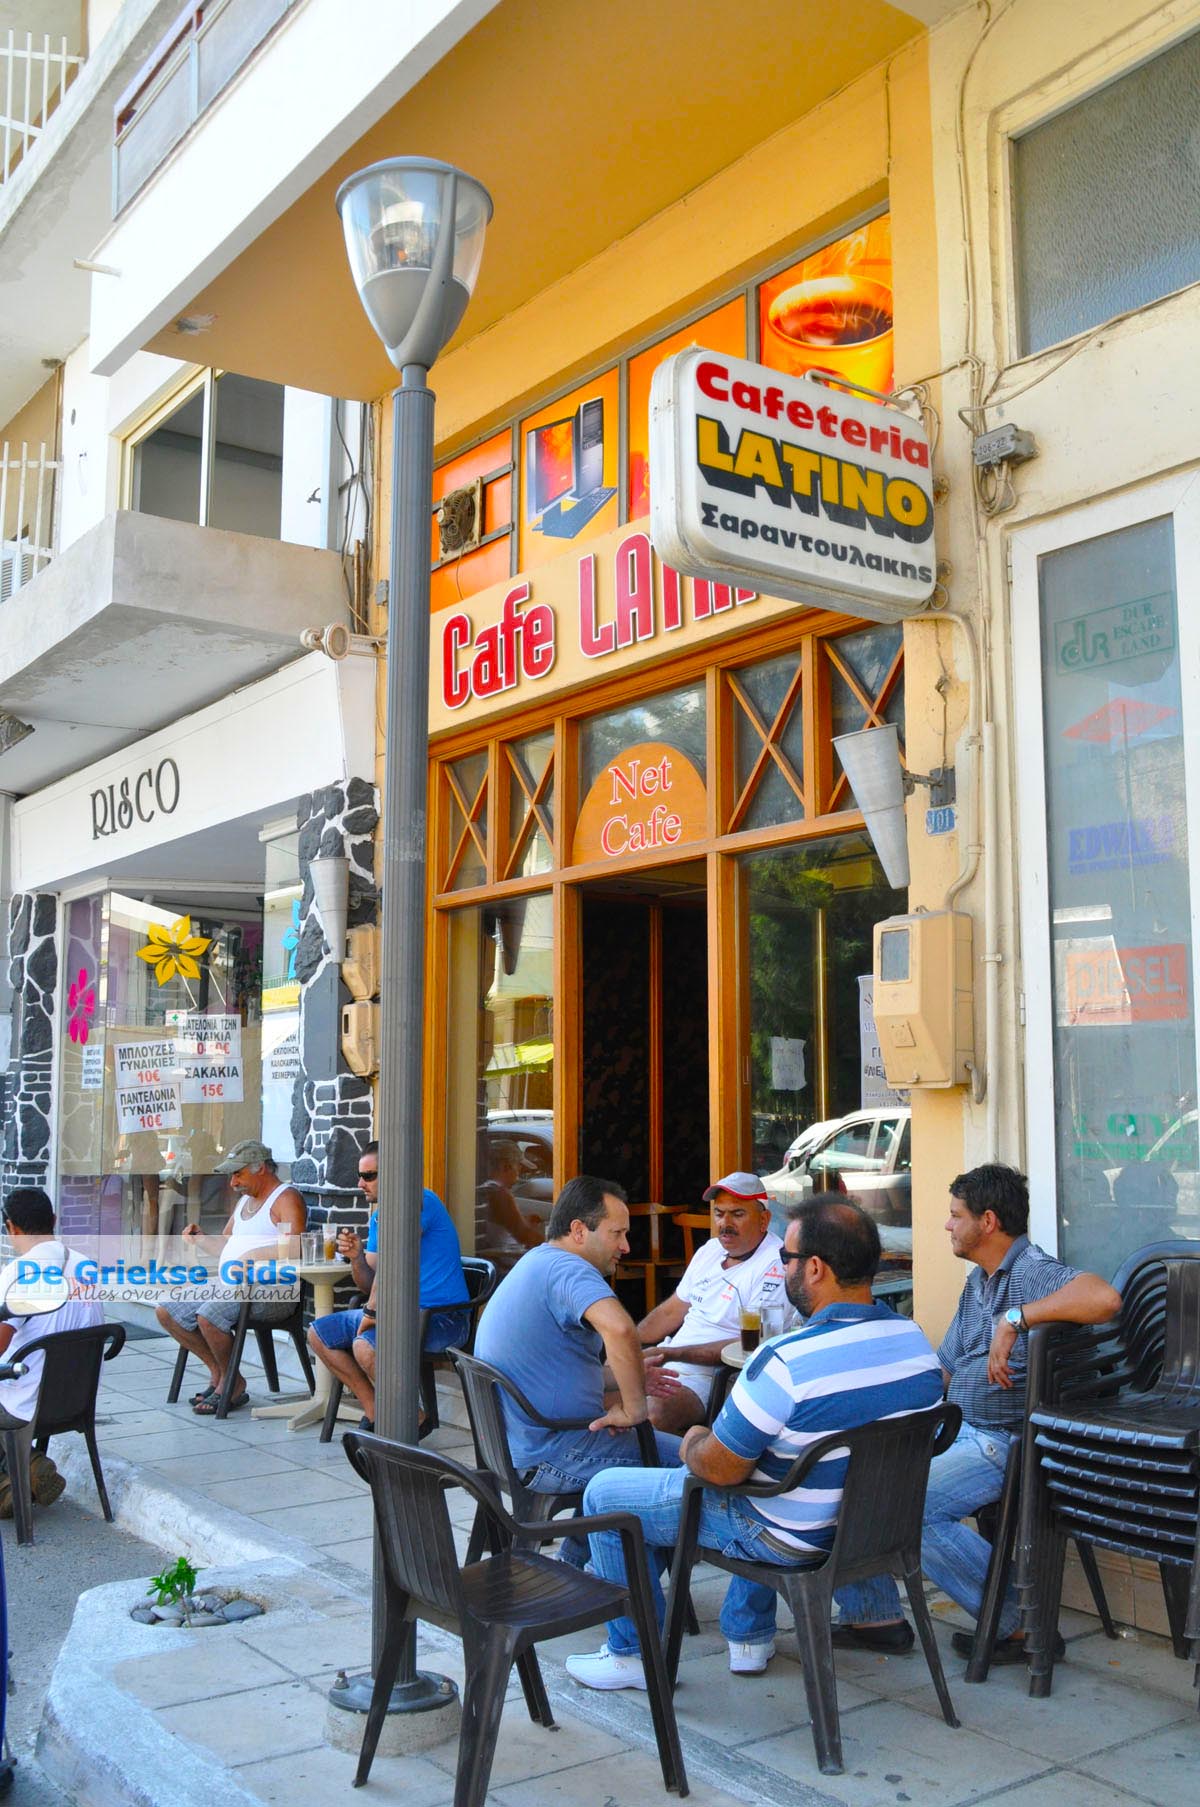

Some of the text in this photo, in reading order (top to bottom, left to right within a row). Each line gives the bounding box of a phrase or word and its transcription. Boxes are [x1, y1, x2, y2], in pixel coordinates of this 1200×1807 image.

[696, 362, 928, 468] Cafeteria
[696, 414, 934, 544] LATINO
[701, 502, 932, 584] Σαραντουλακης
[443, 581, 555, 710] Cafe
[608, 756, 672, 805] Net
[90, 758, 180, 840] RISCO
[601, 804, 681, 856] Cafe
[1075, 956, 1180, 997] DIESEL
[221, 1018, 237, 1031] ΤΖΗΝ
[118, 1043, 175, 1060] ΜΠΛΟΥΖΕΣ
[120, 1056, 176, 1071] ΓΥΝΑΙΚΙΕΣ
[184, 1066, 240, 1079] ΣΑΚΑΚΙΑ
[138, 1070, 161, 1083] 10€
[120, 1088, 176, 1106] ΠΑΝΤΕΛΟΝΙΑ
[201, 1084, 224, 1097] 15€
[122, 1101, 176, 1117] ΓΥΝΑΙΚΙΑ
[140, 1114, 162, 1128] 10€
